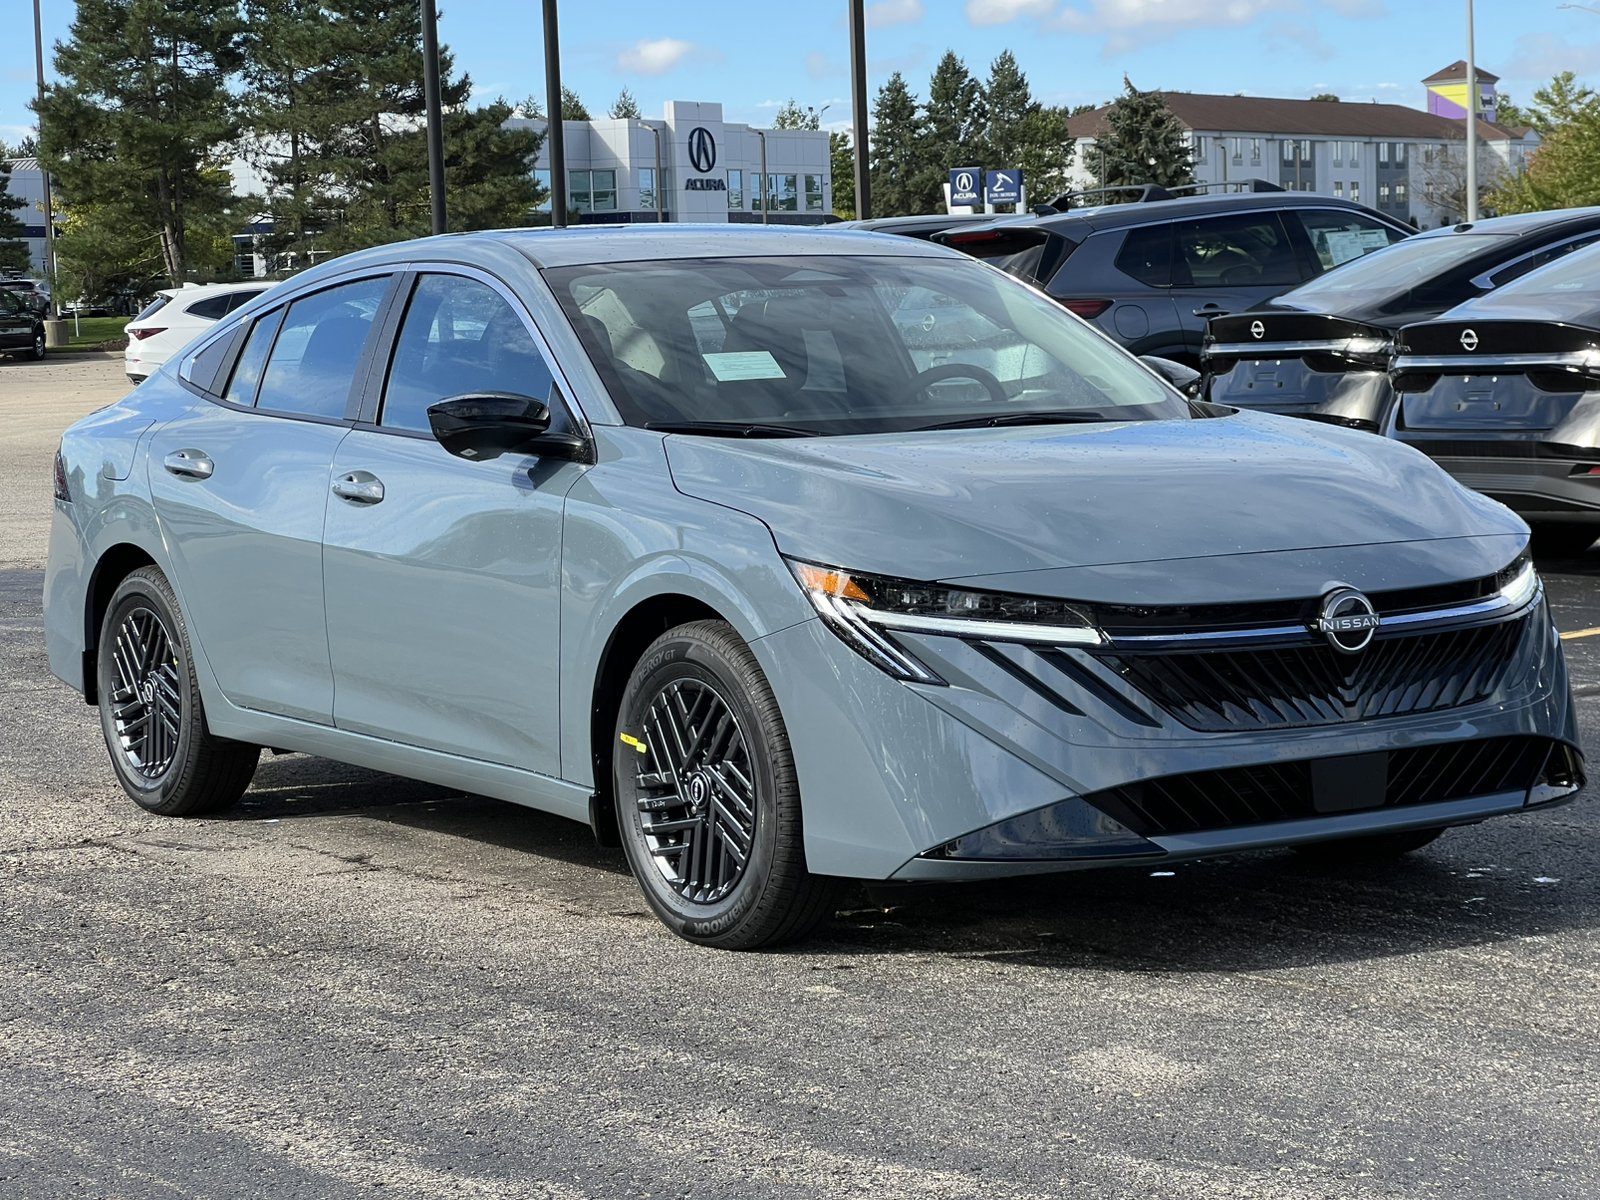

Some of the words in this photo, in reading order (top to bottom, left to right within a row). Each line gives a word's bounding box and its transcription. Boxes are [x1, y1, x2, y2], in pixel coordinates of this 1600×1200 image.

[685, 178, 727, 191] ACURA
[952, 192, 978, 200] ACURA
[1323, 616, 1380, 631] NISSAN
[630, 650, 665, 697] KINERGY
[664, 649, 676, 661] GT
